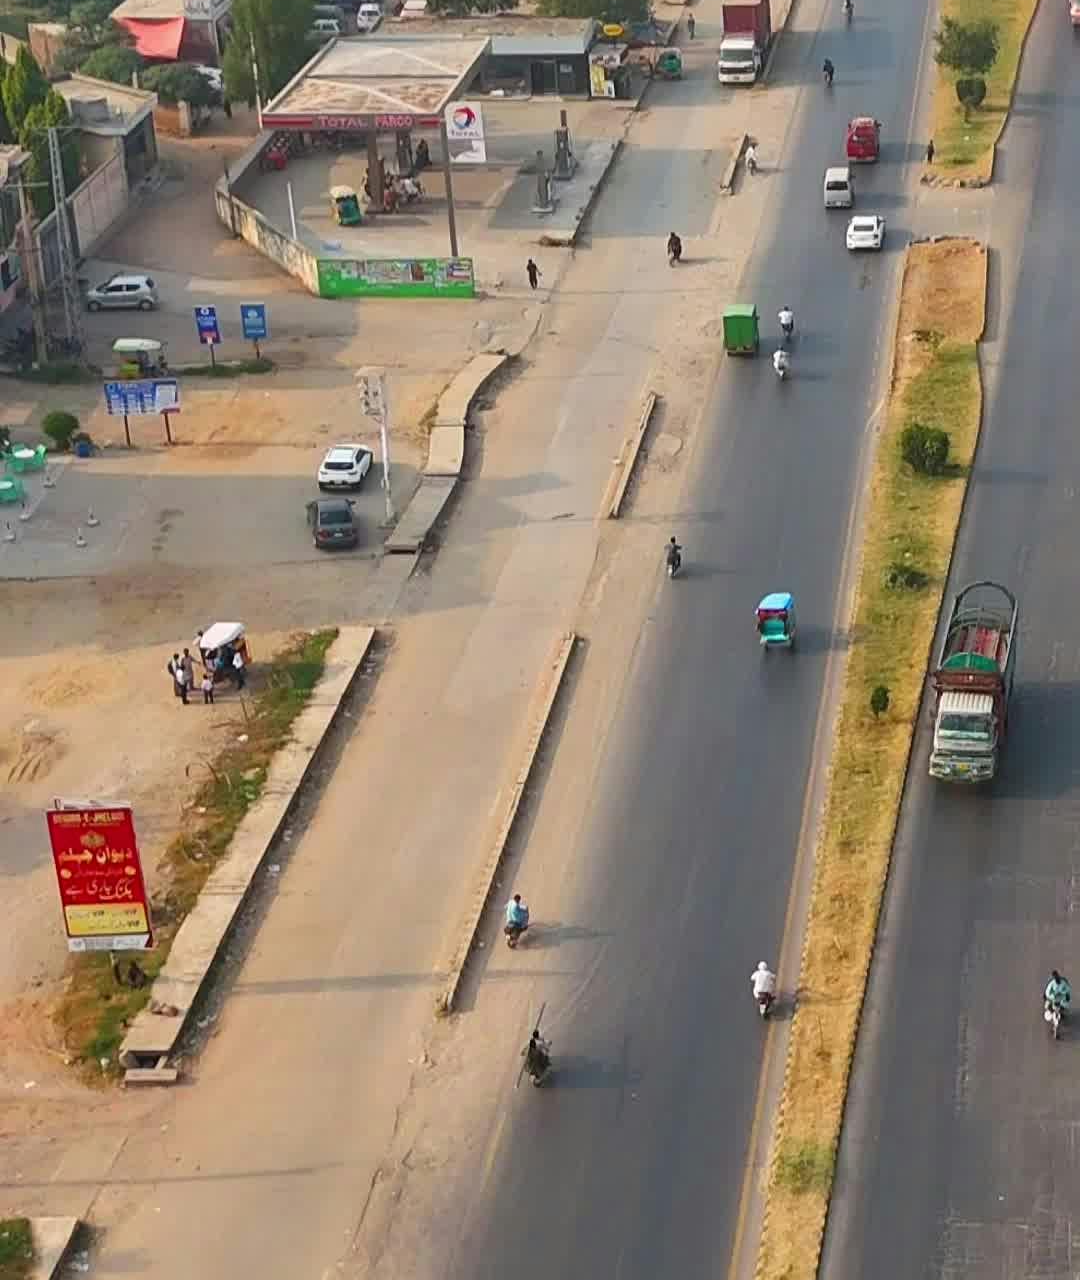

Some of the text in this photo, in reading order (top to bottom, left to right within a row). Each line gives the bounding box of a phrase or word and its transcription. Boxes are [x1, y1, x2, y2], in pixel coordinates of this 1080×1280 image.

[318, 116, 413, 128] TOTAL PARCO
[450, 129, 480, 137] TOTAL
